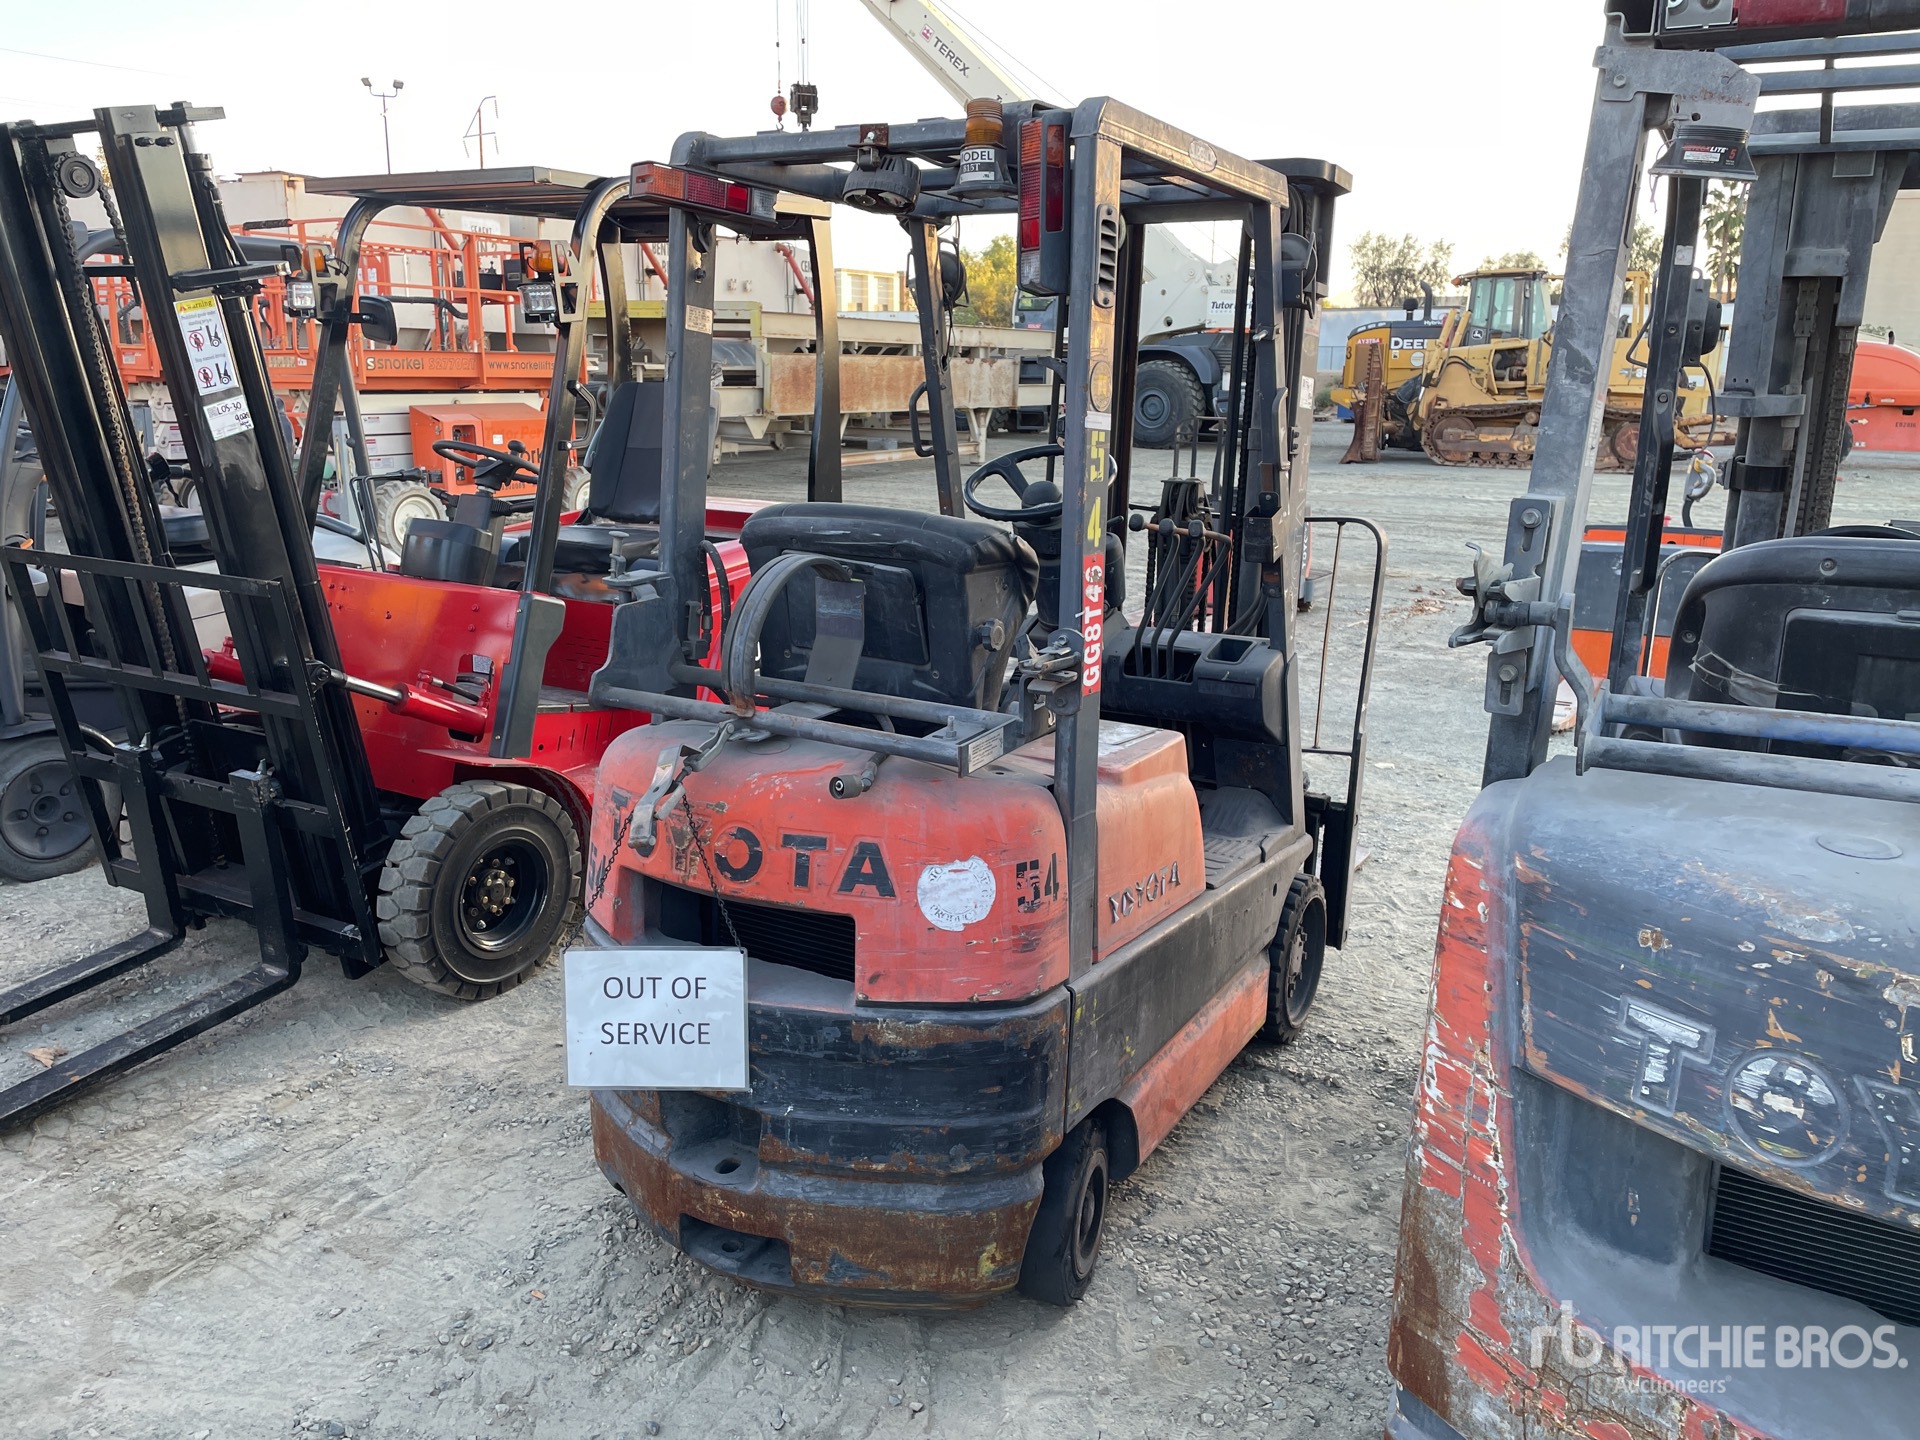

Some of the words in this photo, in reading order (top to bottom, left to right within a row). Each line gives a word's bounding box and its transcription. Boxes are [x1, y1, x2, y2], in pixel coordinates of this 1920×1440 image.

[934, 36, 970, 76] TEREX
[1211, 301, 1234, 309] Tutor
[1346, 346, 1353, 360] 3
[611, 788, 897, 899] TYOTA
[1016, 852, 1060, 913] 54
[1109, 861, 1181, 925] TOYOTA
[603, 976, 662, 999] OUT
[671, 976, 707, 999] OF
[600, 1022, 711, 1045] SERVICE
